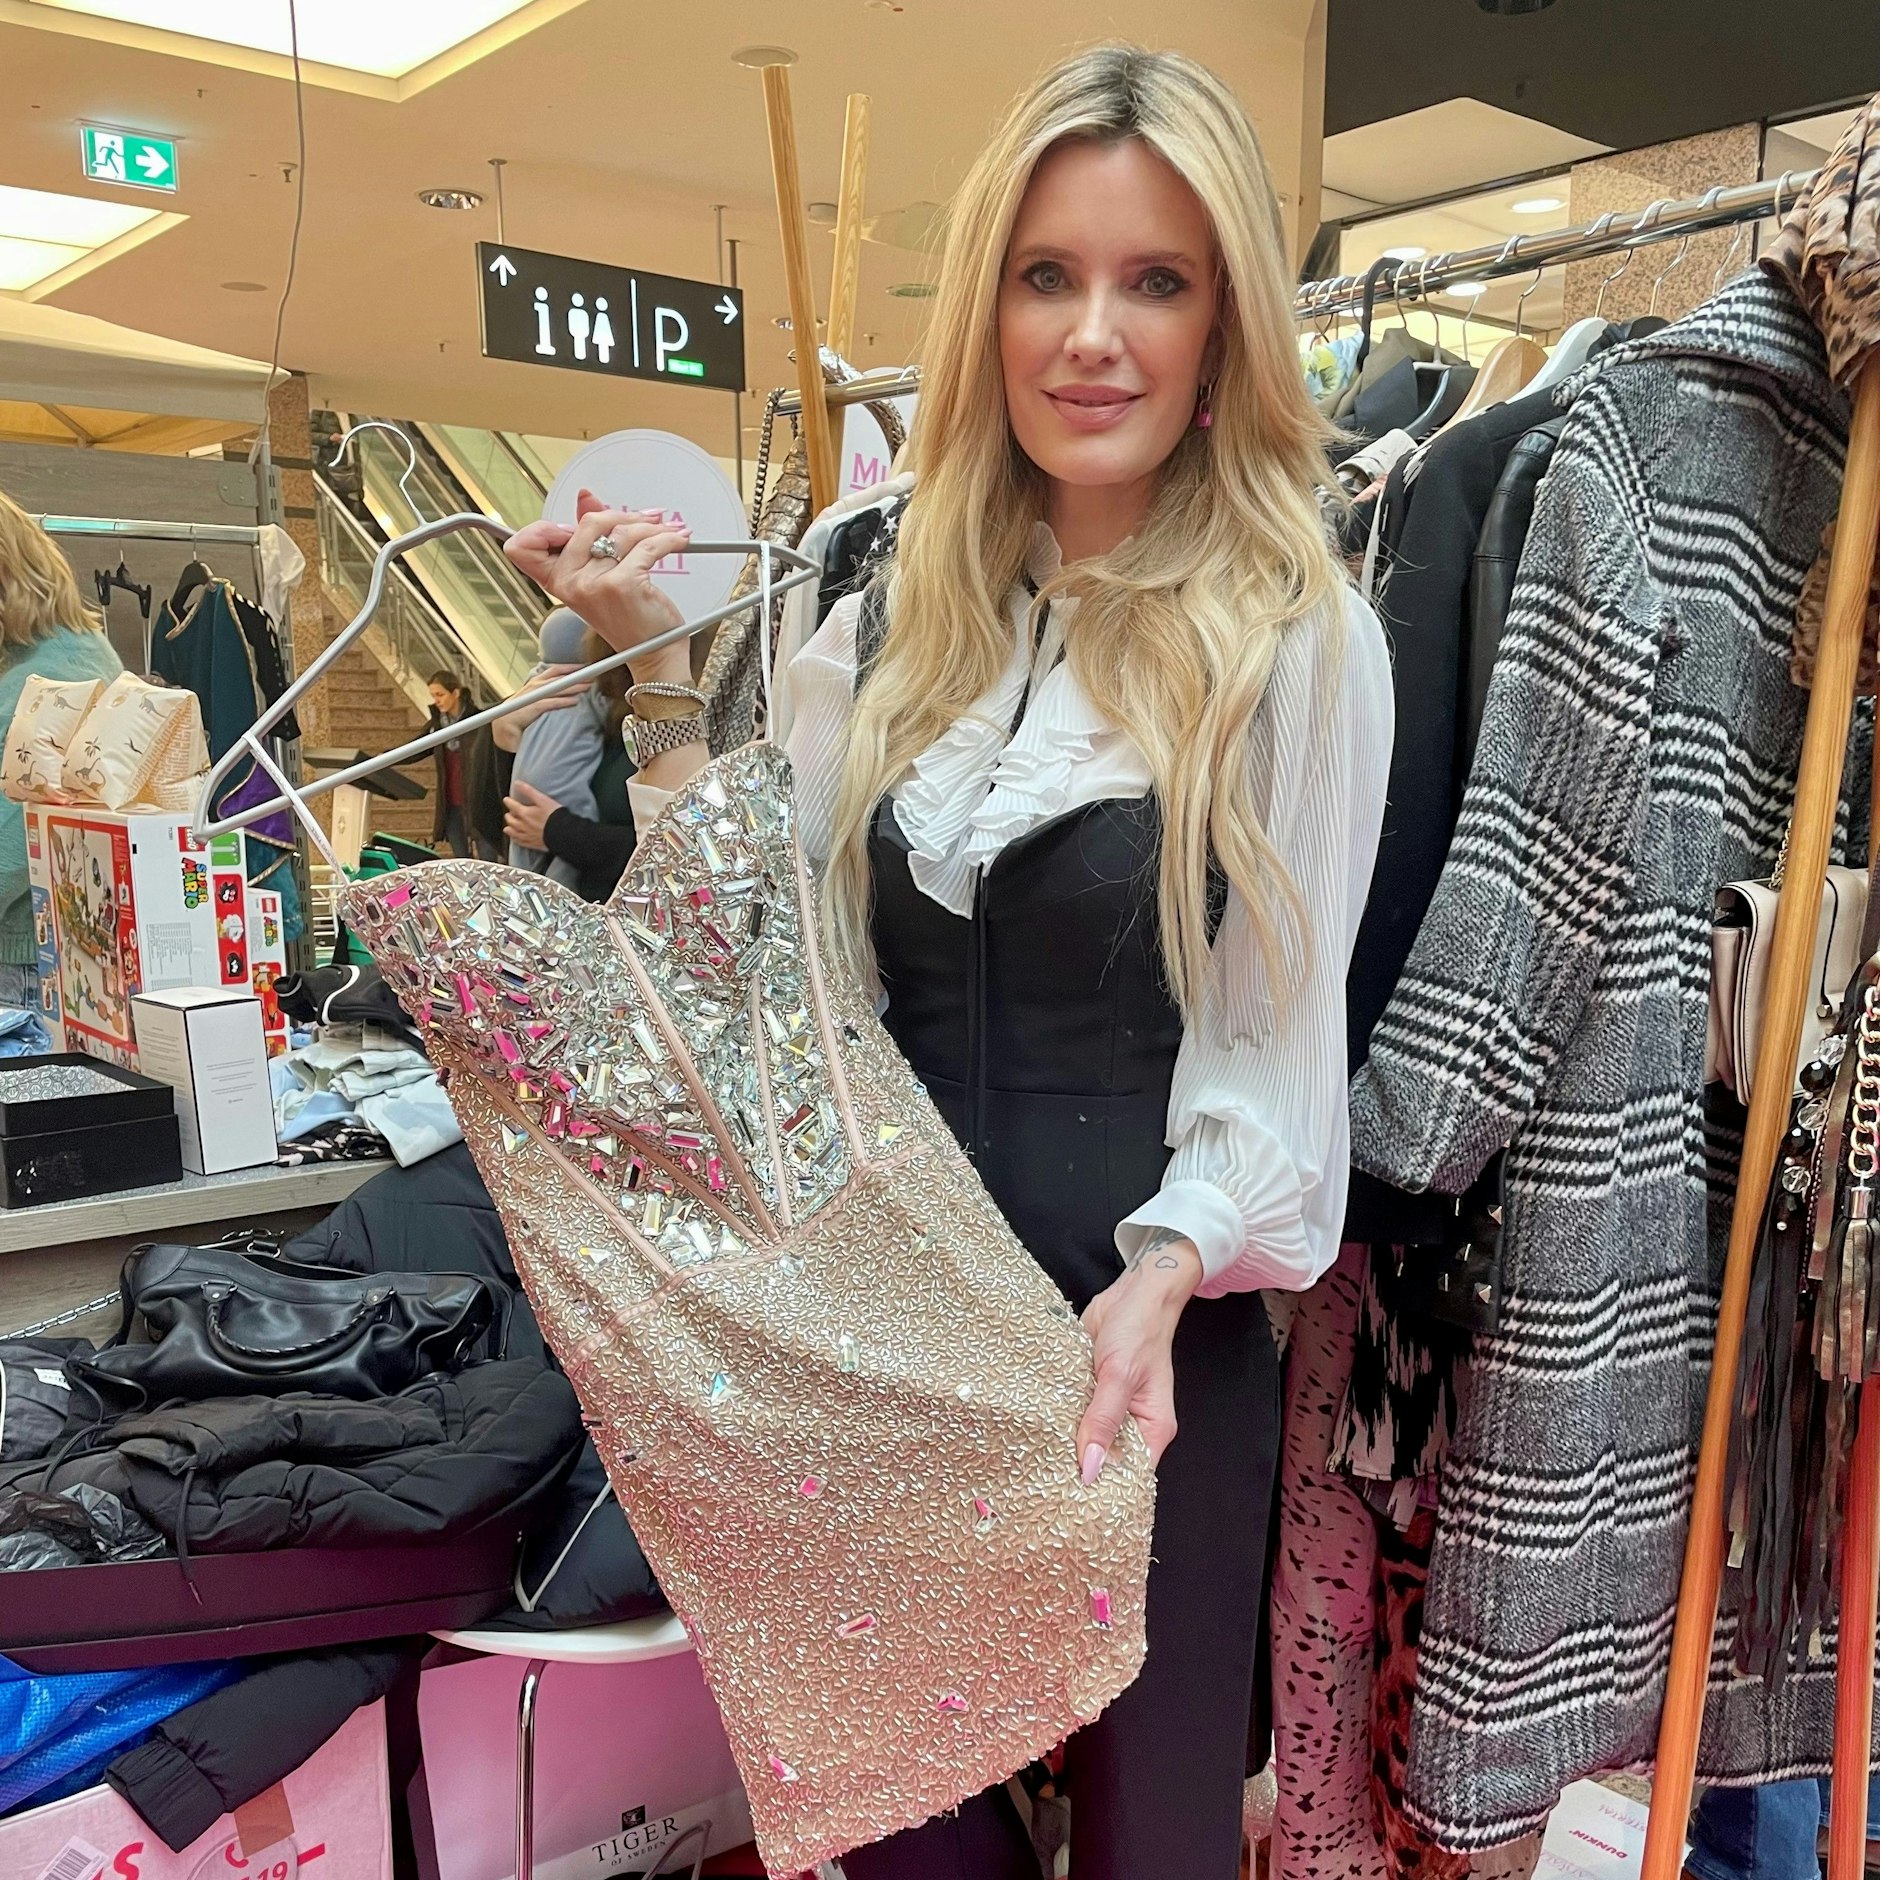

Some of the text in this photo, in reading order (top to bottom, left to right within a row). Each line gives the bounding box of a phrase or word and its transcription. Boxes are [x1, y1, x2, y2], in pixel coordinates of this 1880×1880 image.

[655, 306, 689, 371] P
[182, 857, 199, 909] MARIO
[196, 863, 209, 903] SUPER
[592, 1817, 678, 1862] TIGER
[611, 1840, 666, 1866] OF SWEDEN
